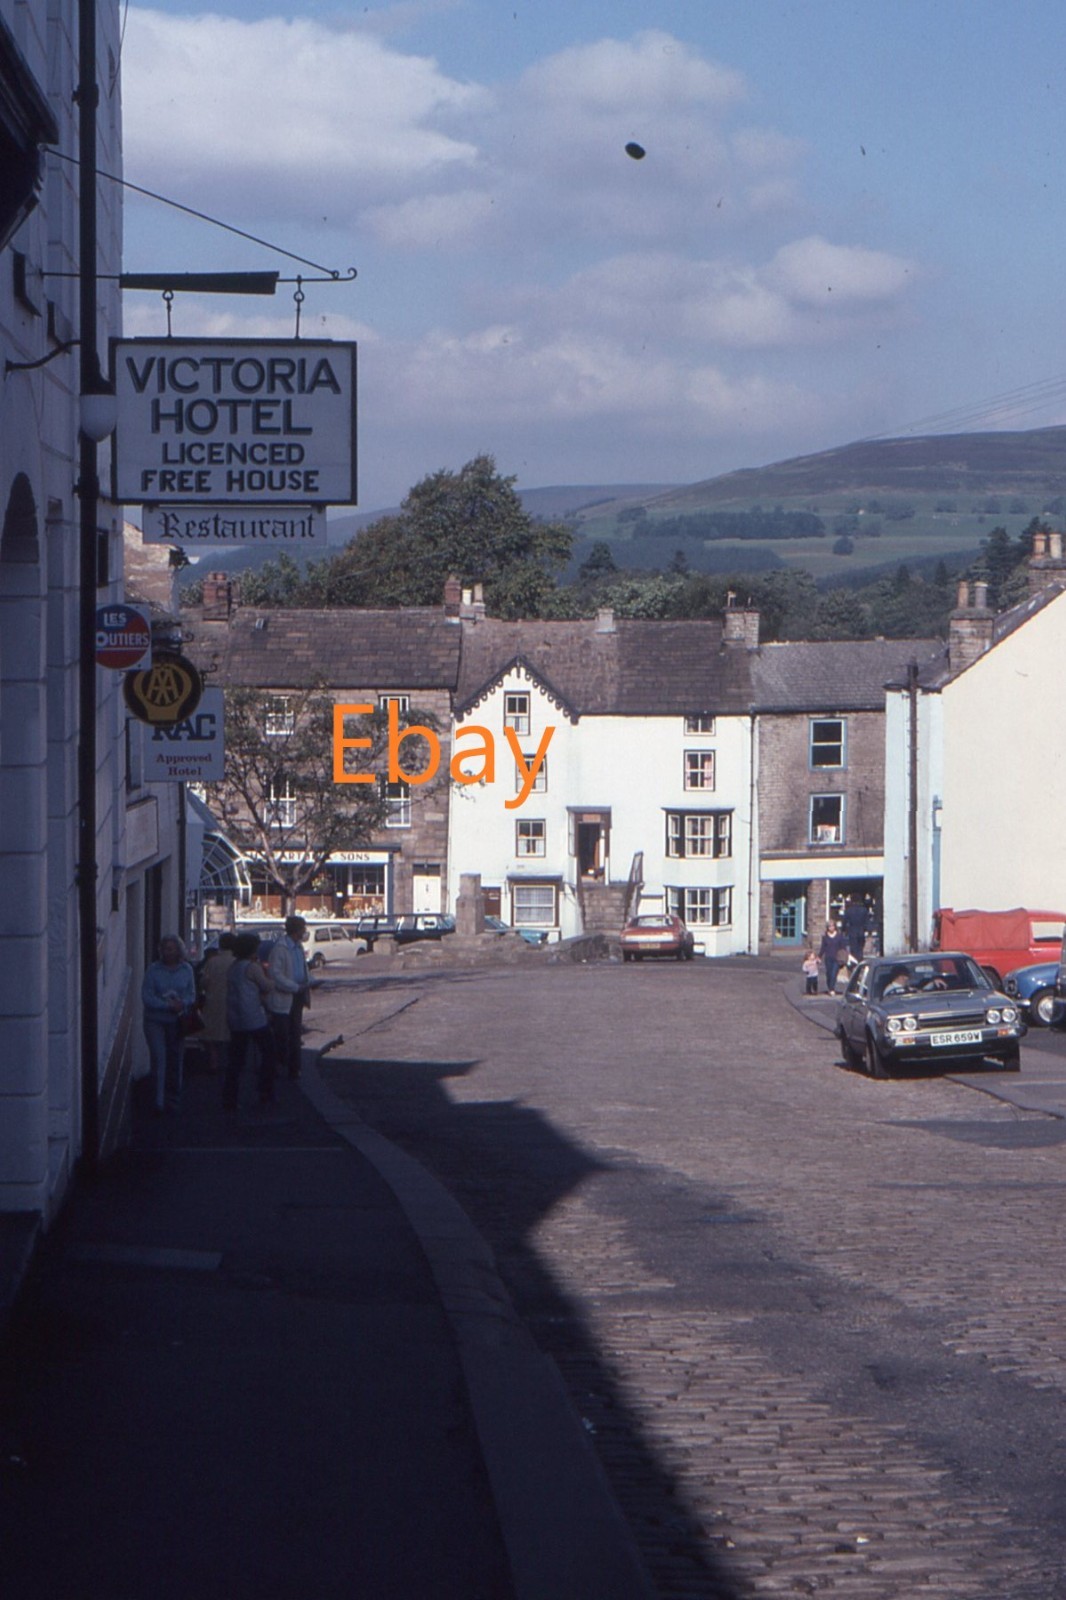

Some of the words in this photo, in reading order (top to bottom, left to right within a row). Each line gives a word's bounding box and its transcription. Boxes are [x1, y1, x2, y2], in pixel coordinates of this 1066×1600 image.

[125, 356, 342, 395] VICTORIA
[150, 397, 314, 436] HOTEL
[161, 442, 305, 466] LICENCED
[140, 469, 212, 493] FREE
[225, 469, 320, 493] HOUSE
[157, 511, 316, 540] Restaurant
[103, 612, 127, 627] LES
[95, 631, 149, 647] OUTIERS
[156, 753, 213, 765] Approved
[168, 766, 202, 776] Hotel
[932, 1035, 952, 1045] ESR
